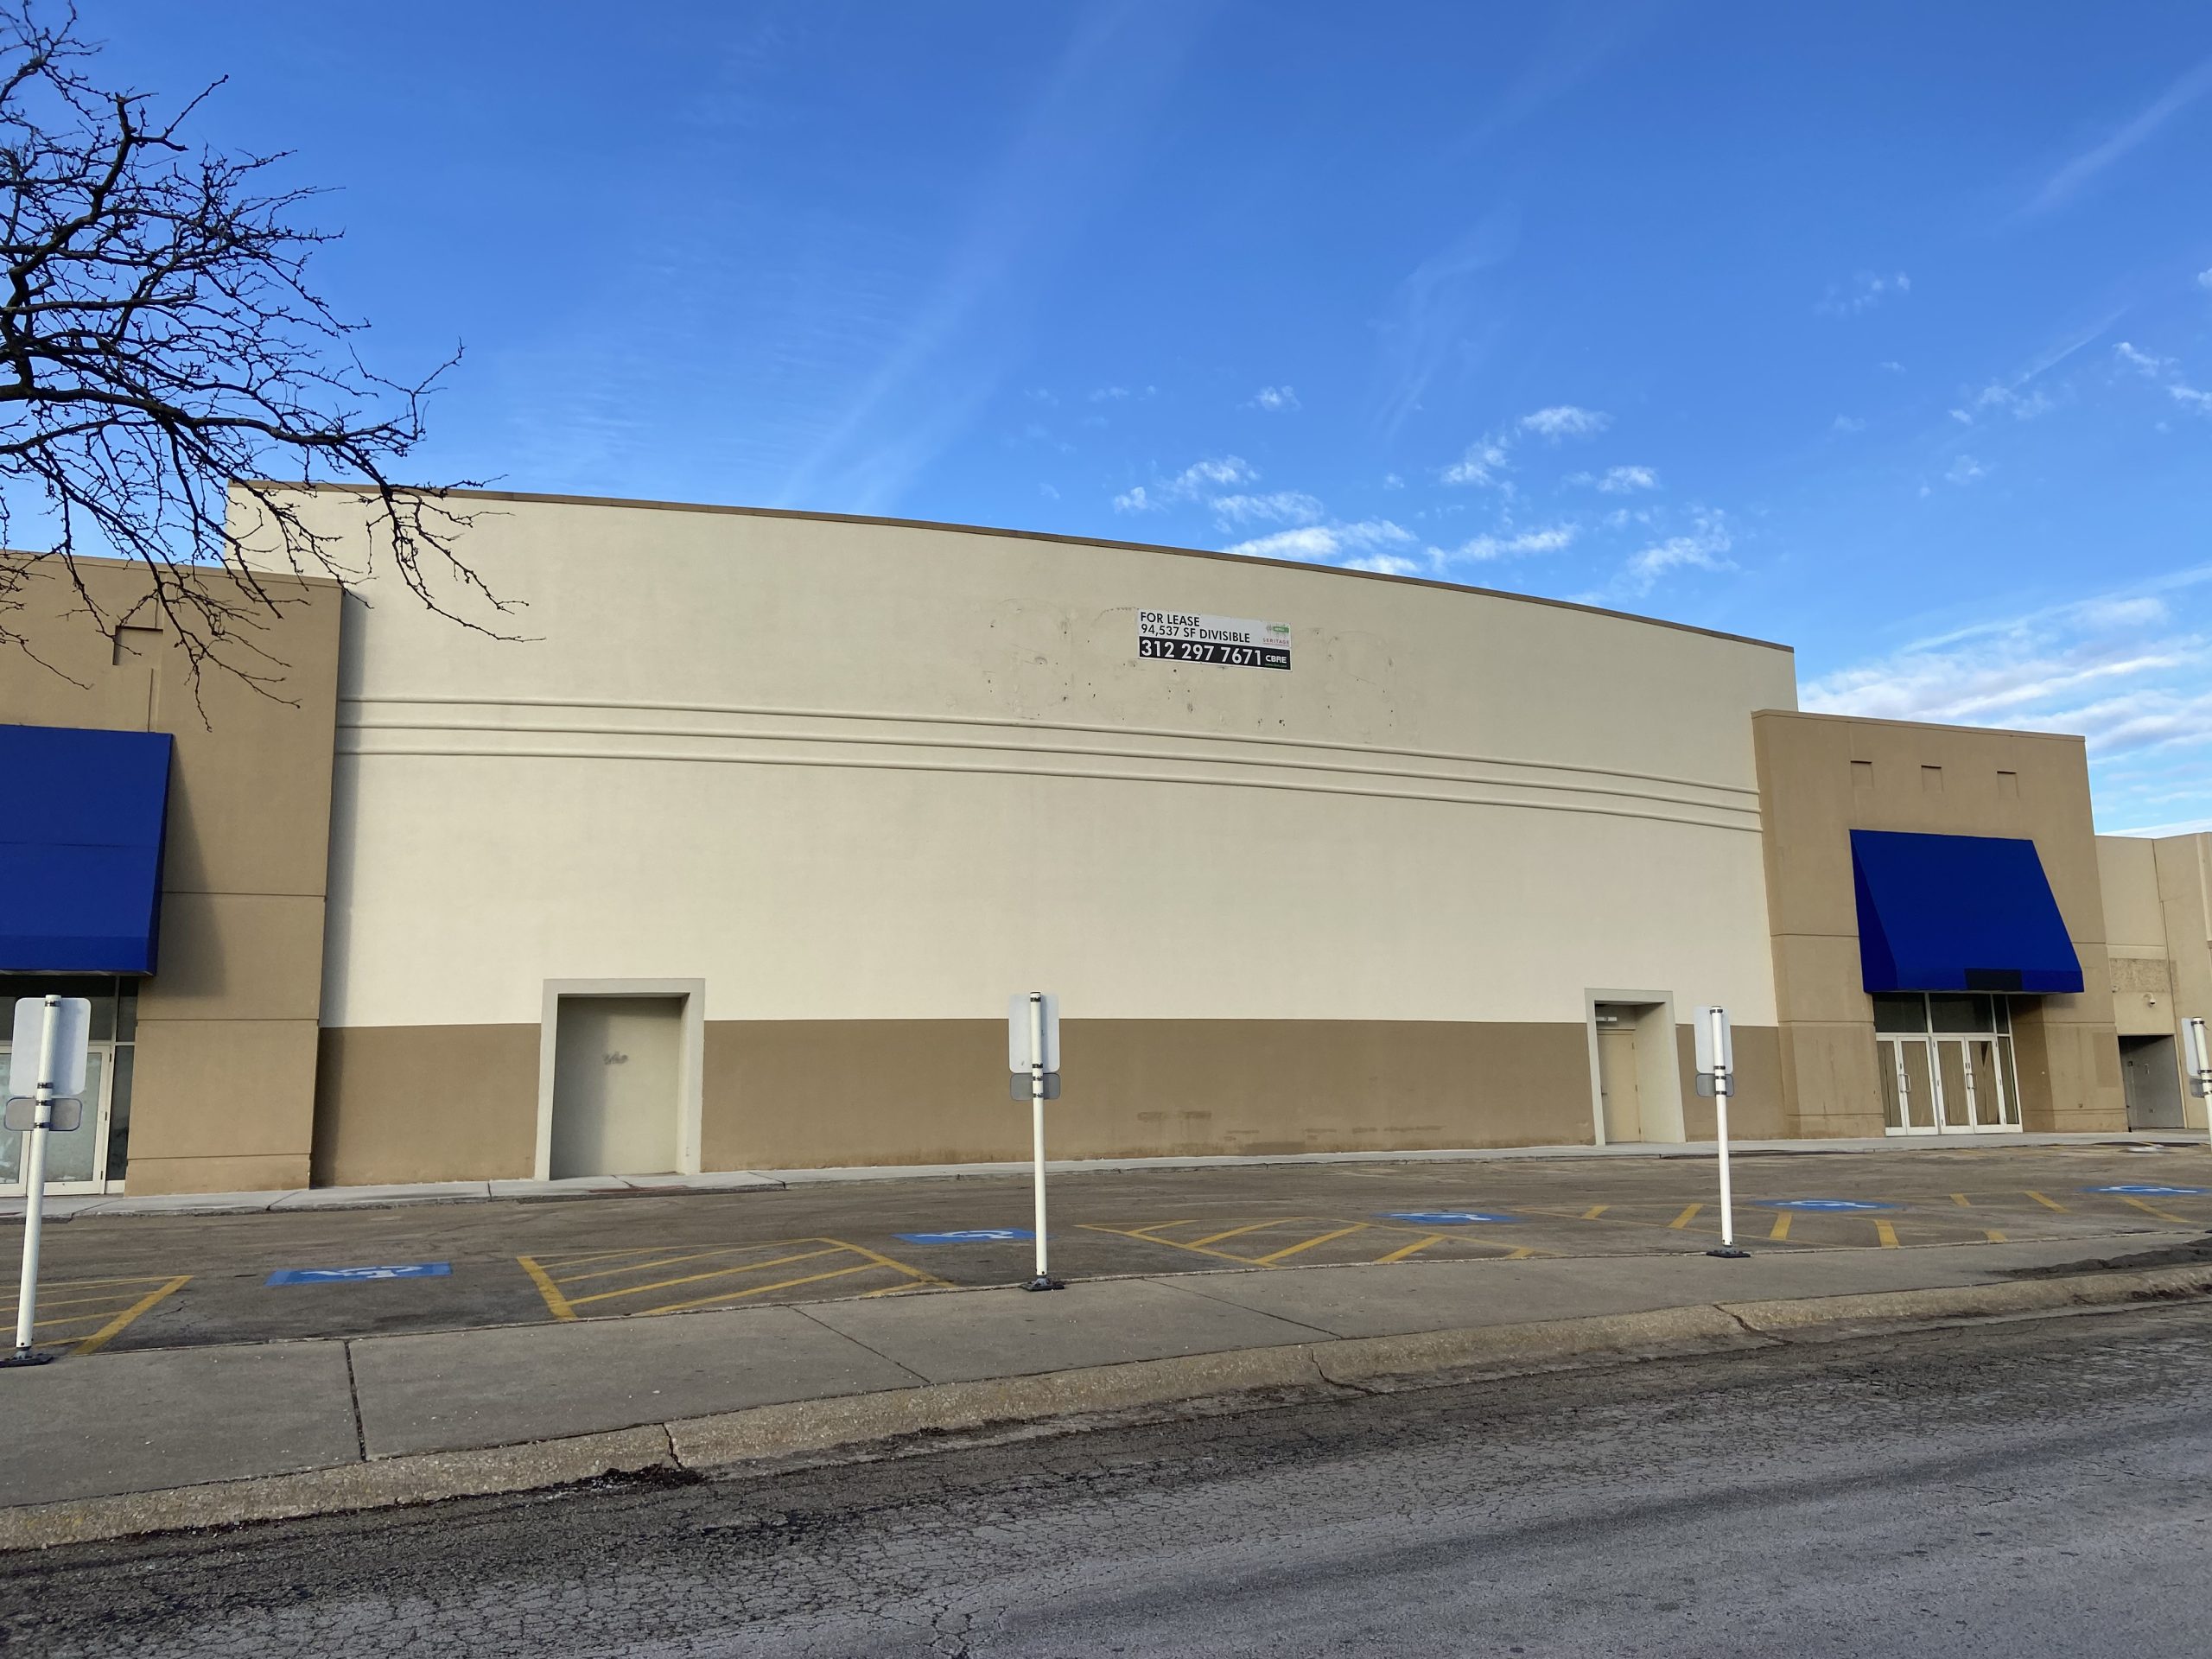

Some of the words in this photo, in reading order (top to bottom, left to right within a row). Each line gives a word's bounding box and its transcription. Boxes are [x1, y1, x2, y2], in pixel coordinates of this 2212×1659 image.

[1140, 612, 1163, 624] FOR
[1167, 614, 1200, 626] LEASE
[1141, 624, 1179, 637] 94,537
[1184, 627, 1196, 638] SF
[1199, 629, 1250, 643] DIVISIBLE
[1141, 639, 1175, 658] 312
[1181, 644, 1215, 661] 297
[1220, 646, 1262, 666] 7671
[1265, 655, 1287, 664] CBRE
